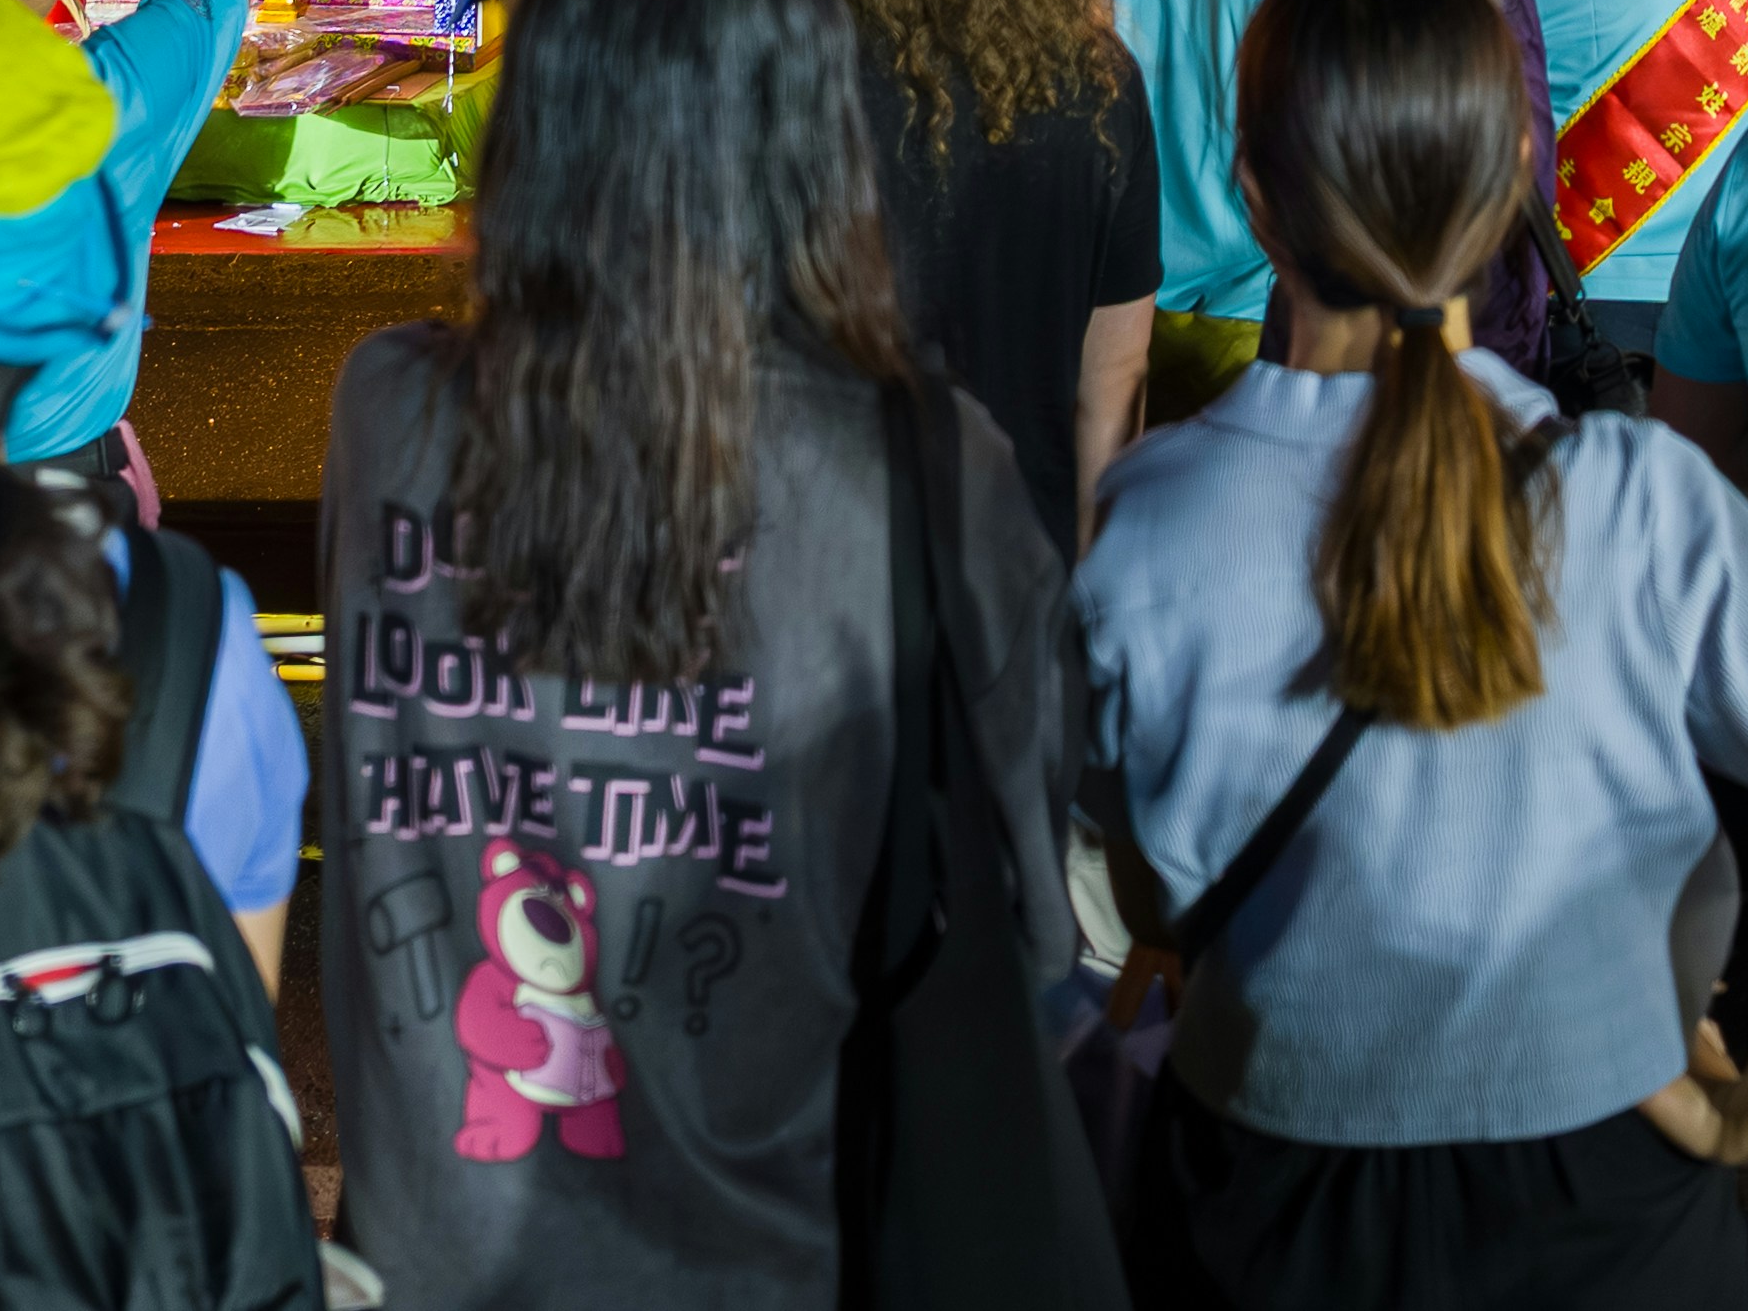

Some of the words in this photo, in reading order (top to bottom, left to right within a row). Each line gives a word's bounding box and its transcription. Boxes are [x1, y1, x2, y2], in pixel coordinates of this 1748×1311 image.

[350, 610, 536, 723] LOOK
[360, 742, 559, 841] HAVE
[567, 762, 789, 900] TIME
